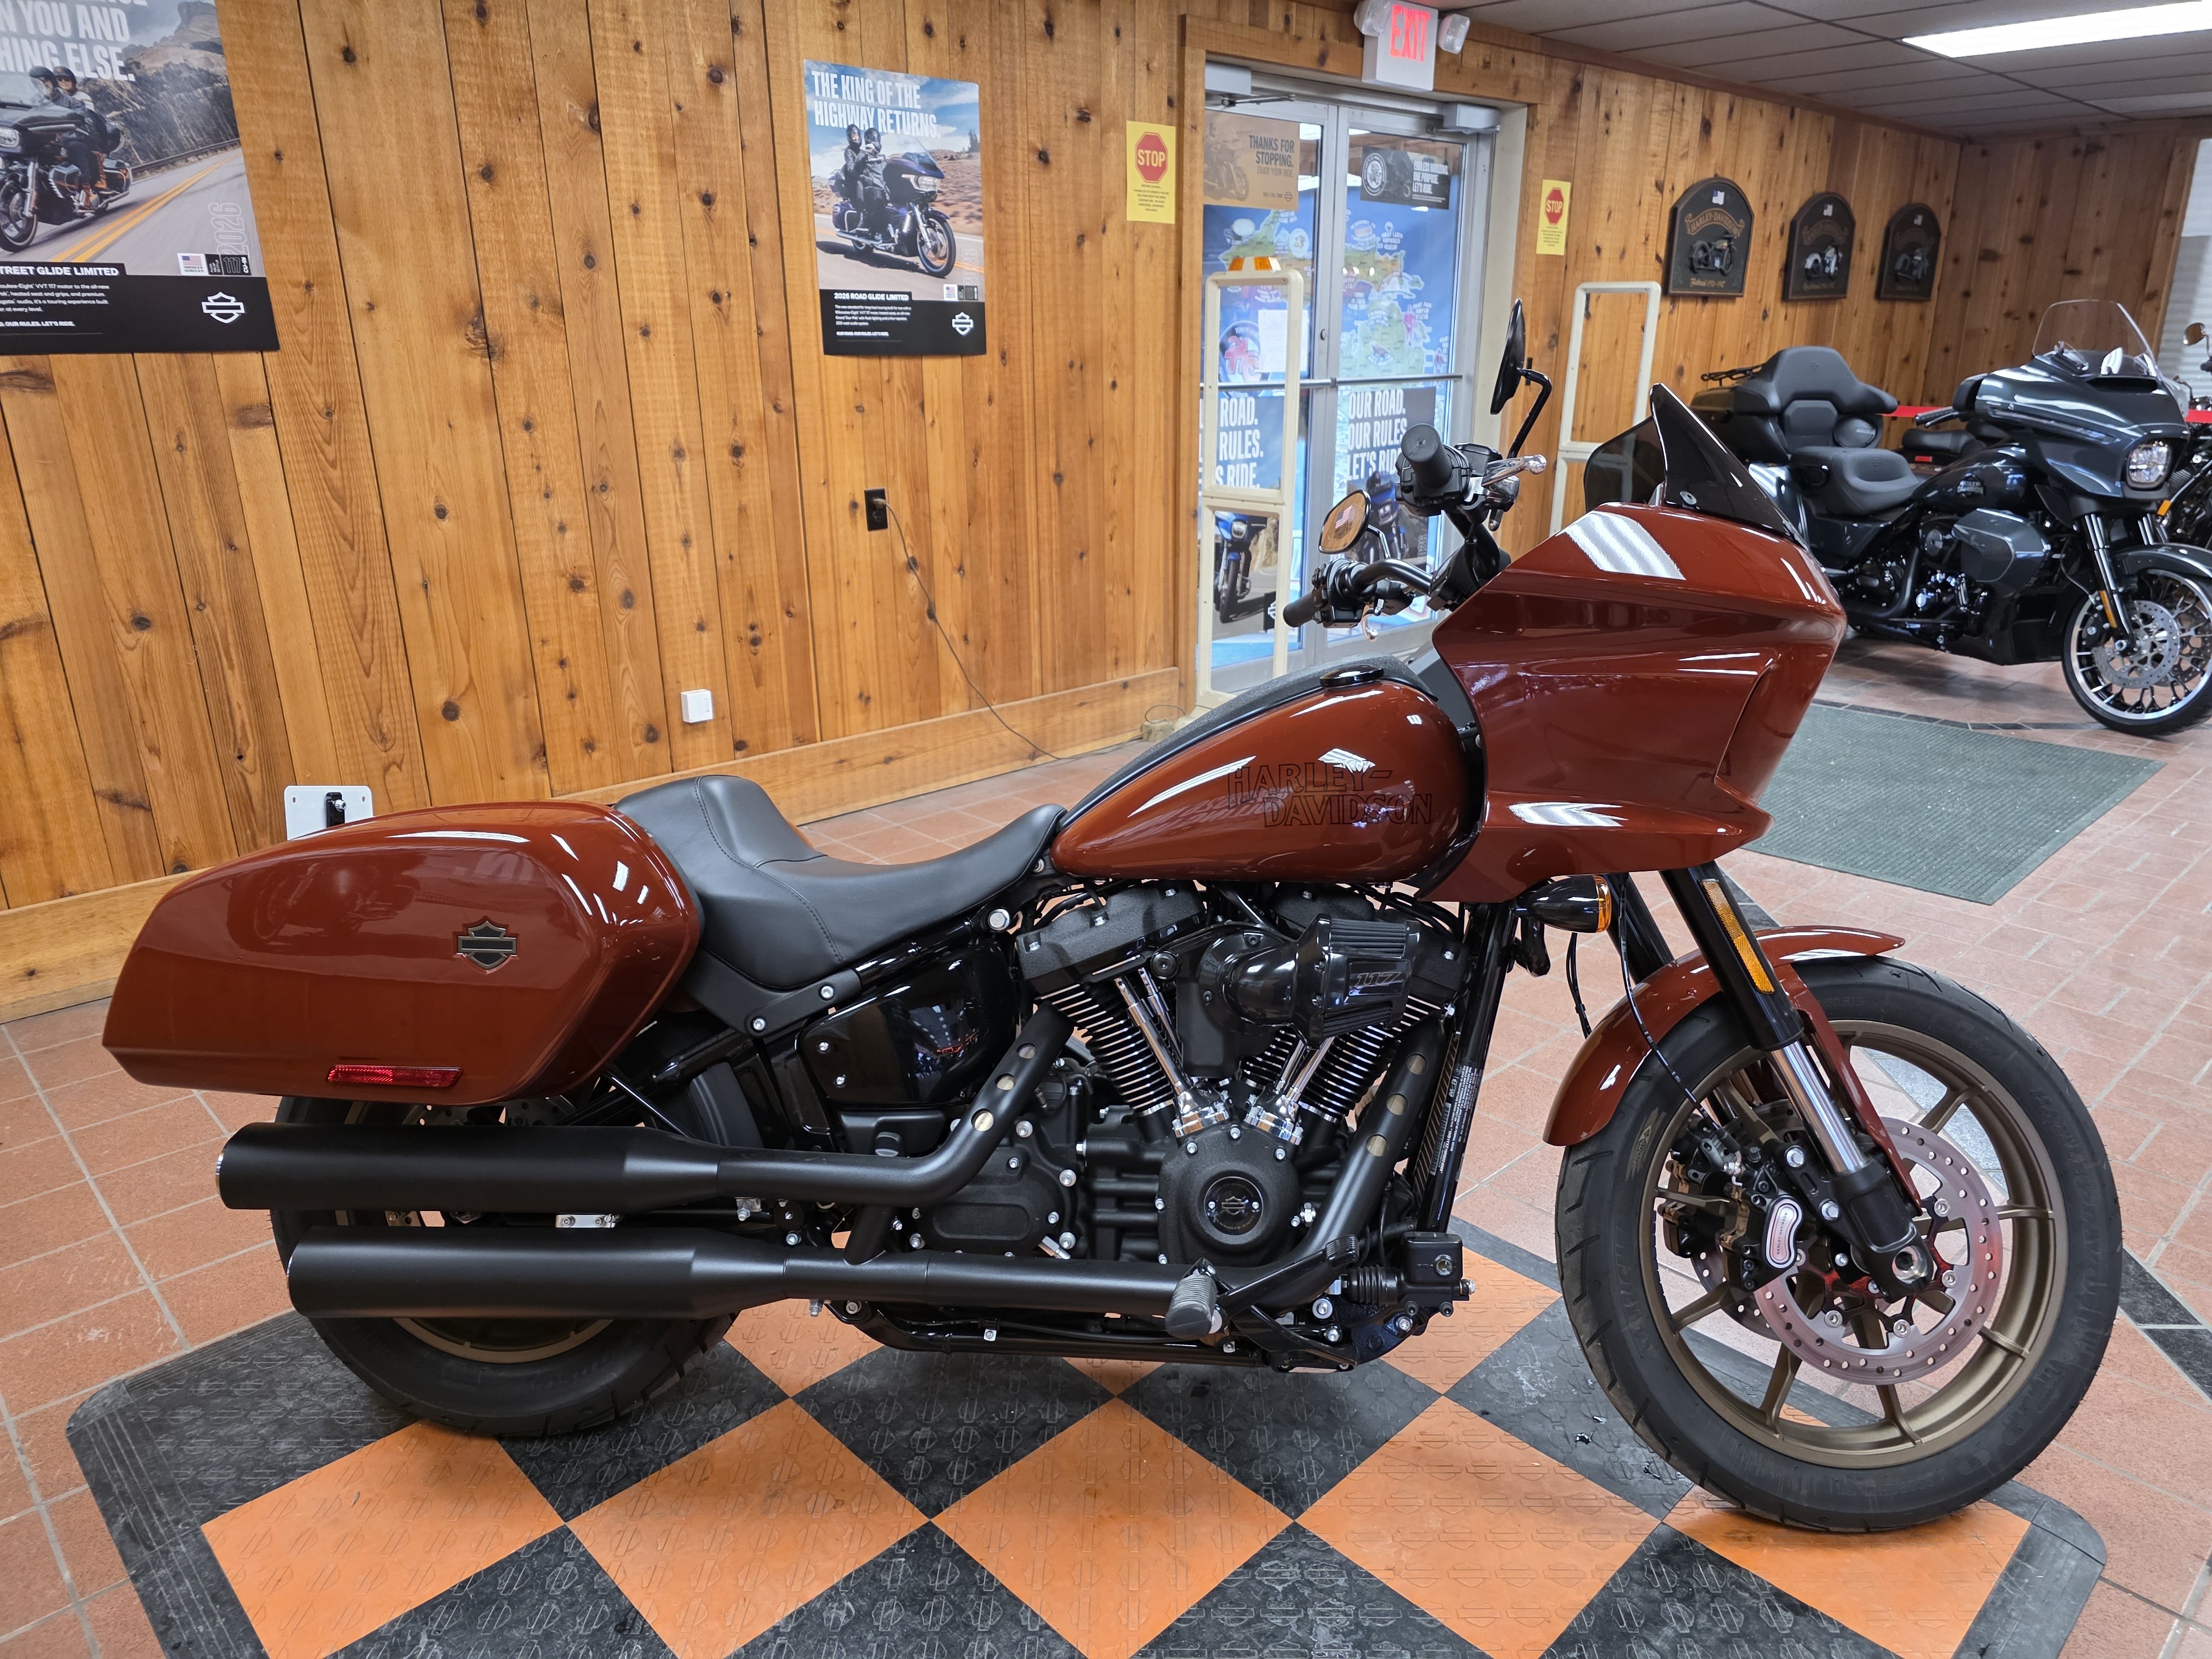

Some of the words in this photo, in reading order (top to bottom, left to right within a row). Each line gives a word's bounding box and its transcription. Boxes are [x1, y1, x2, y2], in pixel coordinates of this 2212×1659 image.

[18, 0, 72, 38] YOU
[76, 4, 131, 42] AND
[1390, 4, 1430, 62] EXIT
[64, 42, 135, 81] ELSE.
[811, 70, 839, 99] THE
[841, 75, 875, 103] KING
[877, 80, 893, 106] OF
[894, 82, 921, 109] THE
[814, 100, 875, 132] HIGHWAY
[878, 108, 940, 139] RETURNS.
[1138, 149, 1165, 168] STOP
[1249, 135, 1279, 152] THANKS
[1280, 139, 1295, 153] FOR
[1255, 151, 1293, 168] STOPPING.
[1546, 200, 1563, 213] STOP
[208, 202, 249, 255] 2026
[36, 267, 71, 275] GLIDE
[73, 267, 119, 276] LIMITED
[1220, 397, 1258, 427] ROAD.
[1349, 392, 1372, 420] OUR
[1374, 389, 1406, 416] ROAD.
[1219, 429, 1264, 461] RULES.
[1348, 421, 1370, 451] OUR
[1227, 462, 1260, 488] RIDE.
[1347, 451, 1377, 481] LET'S
[1379, 447, 1401, 474] RID
[1262, 794, 1433, 828] DAVIDSON
[1354, 972, 1401, 987] 117
[1777, 1212, 1788, 1255] HARLEY-DAVIDSON
